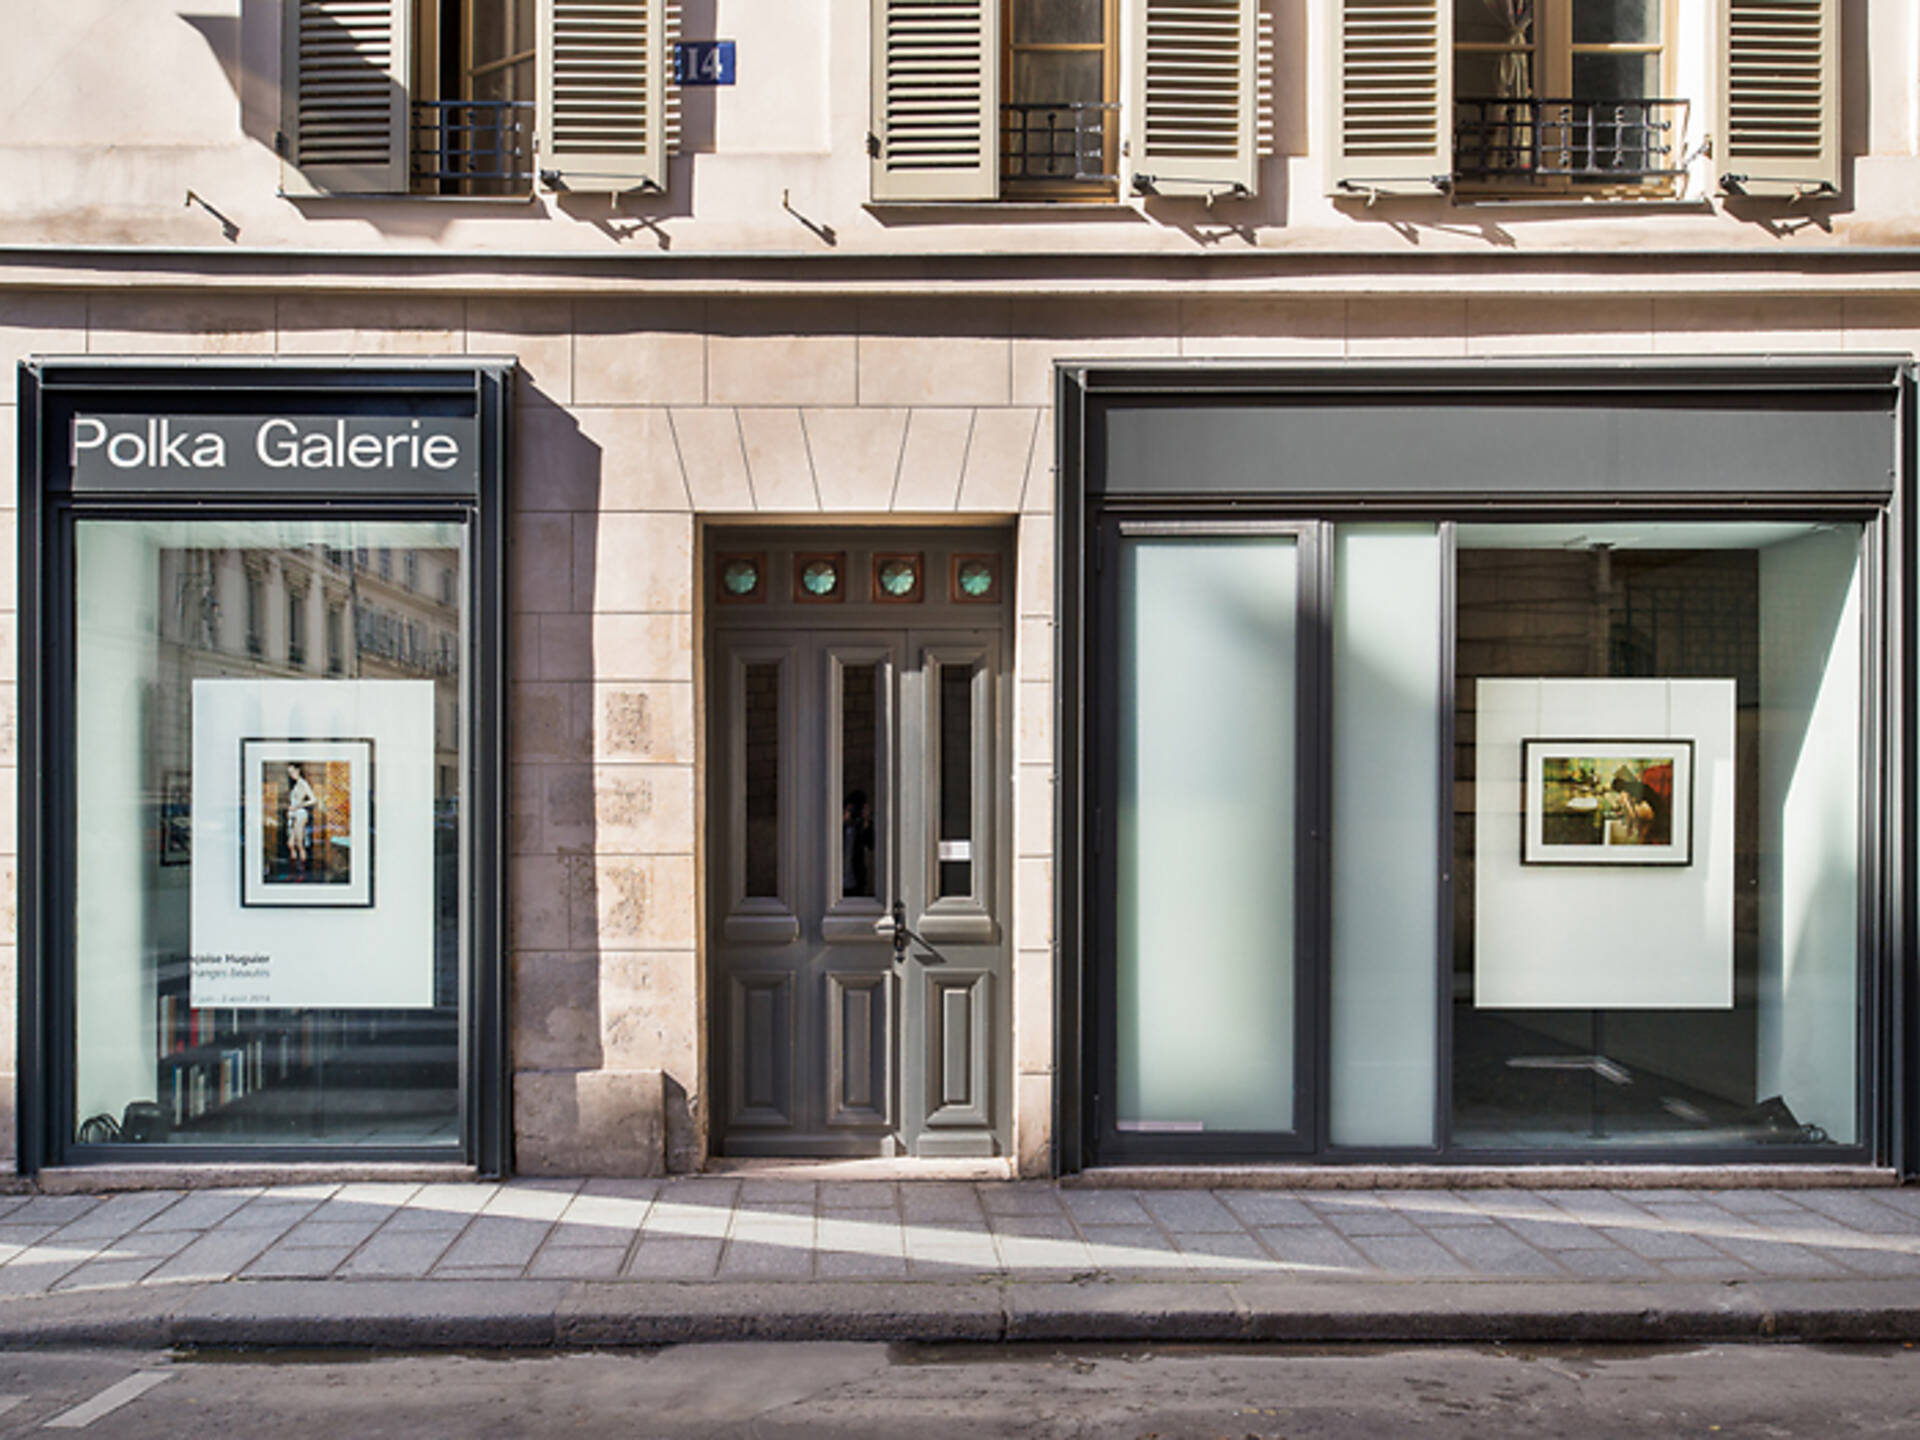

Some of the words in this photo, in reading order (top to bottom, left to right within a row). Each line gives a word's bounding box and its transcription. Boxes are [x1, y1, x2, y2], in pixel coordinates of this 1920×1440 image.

[688, 47, 723, 80] 14
[70, 417, 226, 469] Polka
[256, 418, 459, 470] Galerie
